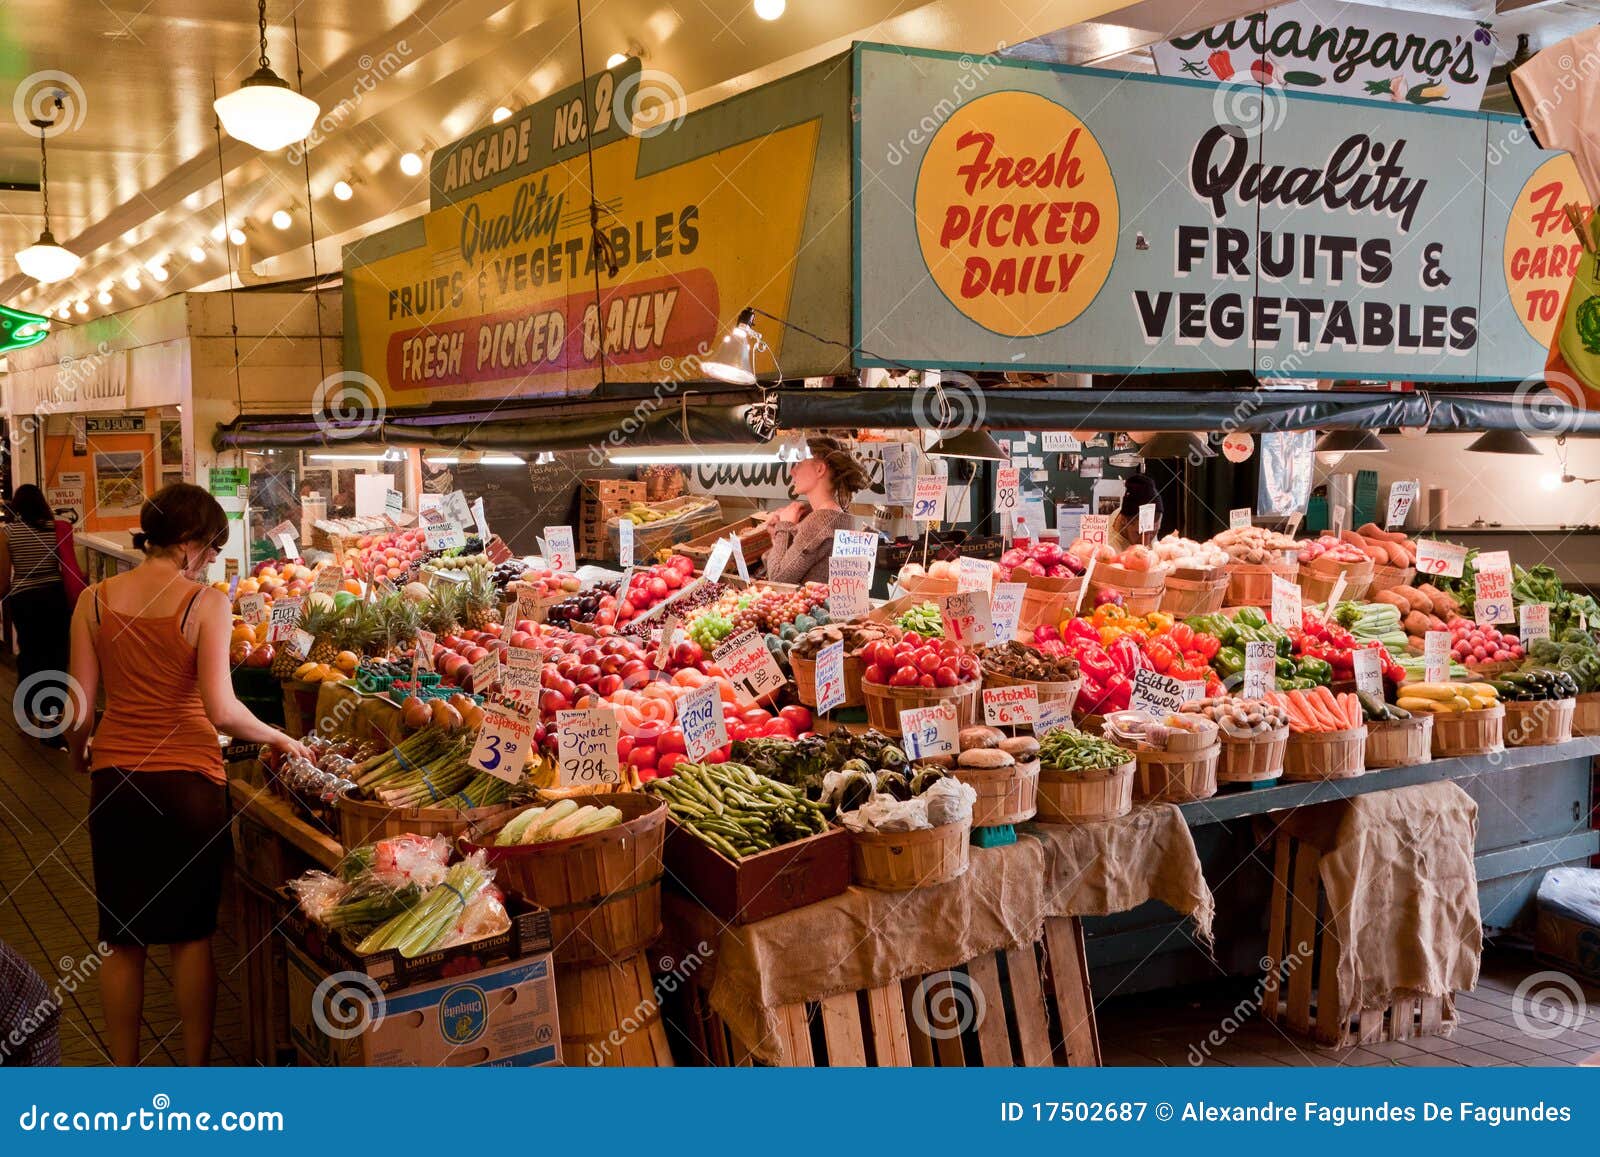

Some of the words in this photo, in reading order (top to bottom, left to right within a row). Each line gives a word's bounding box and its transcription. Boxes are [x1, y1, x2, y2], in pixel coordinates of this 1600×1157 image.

[442, 116, 531, 194] ARCADE
[552, 101, 588, 151] NO.
[591, 71, 614, 135] 2
[955, 127, 1085, 197] Fresh
[1189, 124, 1428, 233] Quality
[460, 174, 565, 267] Quality
[939, 201, 1100, 250] PICKED
[388, 271, 464, 320] FRUITS
[494, 204, 701, 296] VEGETABLES
[1174, 225, 1393, 287] FRUITS
[1421, 242, 1452, 291] &
[960, 253, 1085, 299] DAILY
[1526, 289, 1560, 322] TO
[401, 336, 464, 384] FRESH
[476, 310, 566, 371] PICKED
[583, 287, 680, 360] DAILY
[1133, 290, 1478, 356] VEGETABLES
[914, 499, 937, 517] 98
[839, 532, 873, 545] GREEN
[551, 553, 563, 571] 3
[1420, 557, 1448, 573] 79
[1476, 573, 1505, 587] Baby
[983, 687, 1037, 704] Portobella
[1132, 683, 1181, 713] Flowers
[1135, 668, 1181, 696] Edible
[485, 714, 530, 740] asparagus
[681, 700, 713, 734] Fava
[688, 720, 717, 742] beans
[479, 735, 501, 770] 3
[563, 724, 612, 748] Sweet
[578, 741, 608, 757] Corn
[692, 739, 706, 759] 3
[405, 952, 445, 969] LIMITED
[472, 936, 510, 951] EDITION
